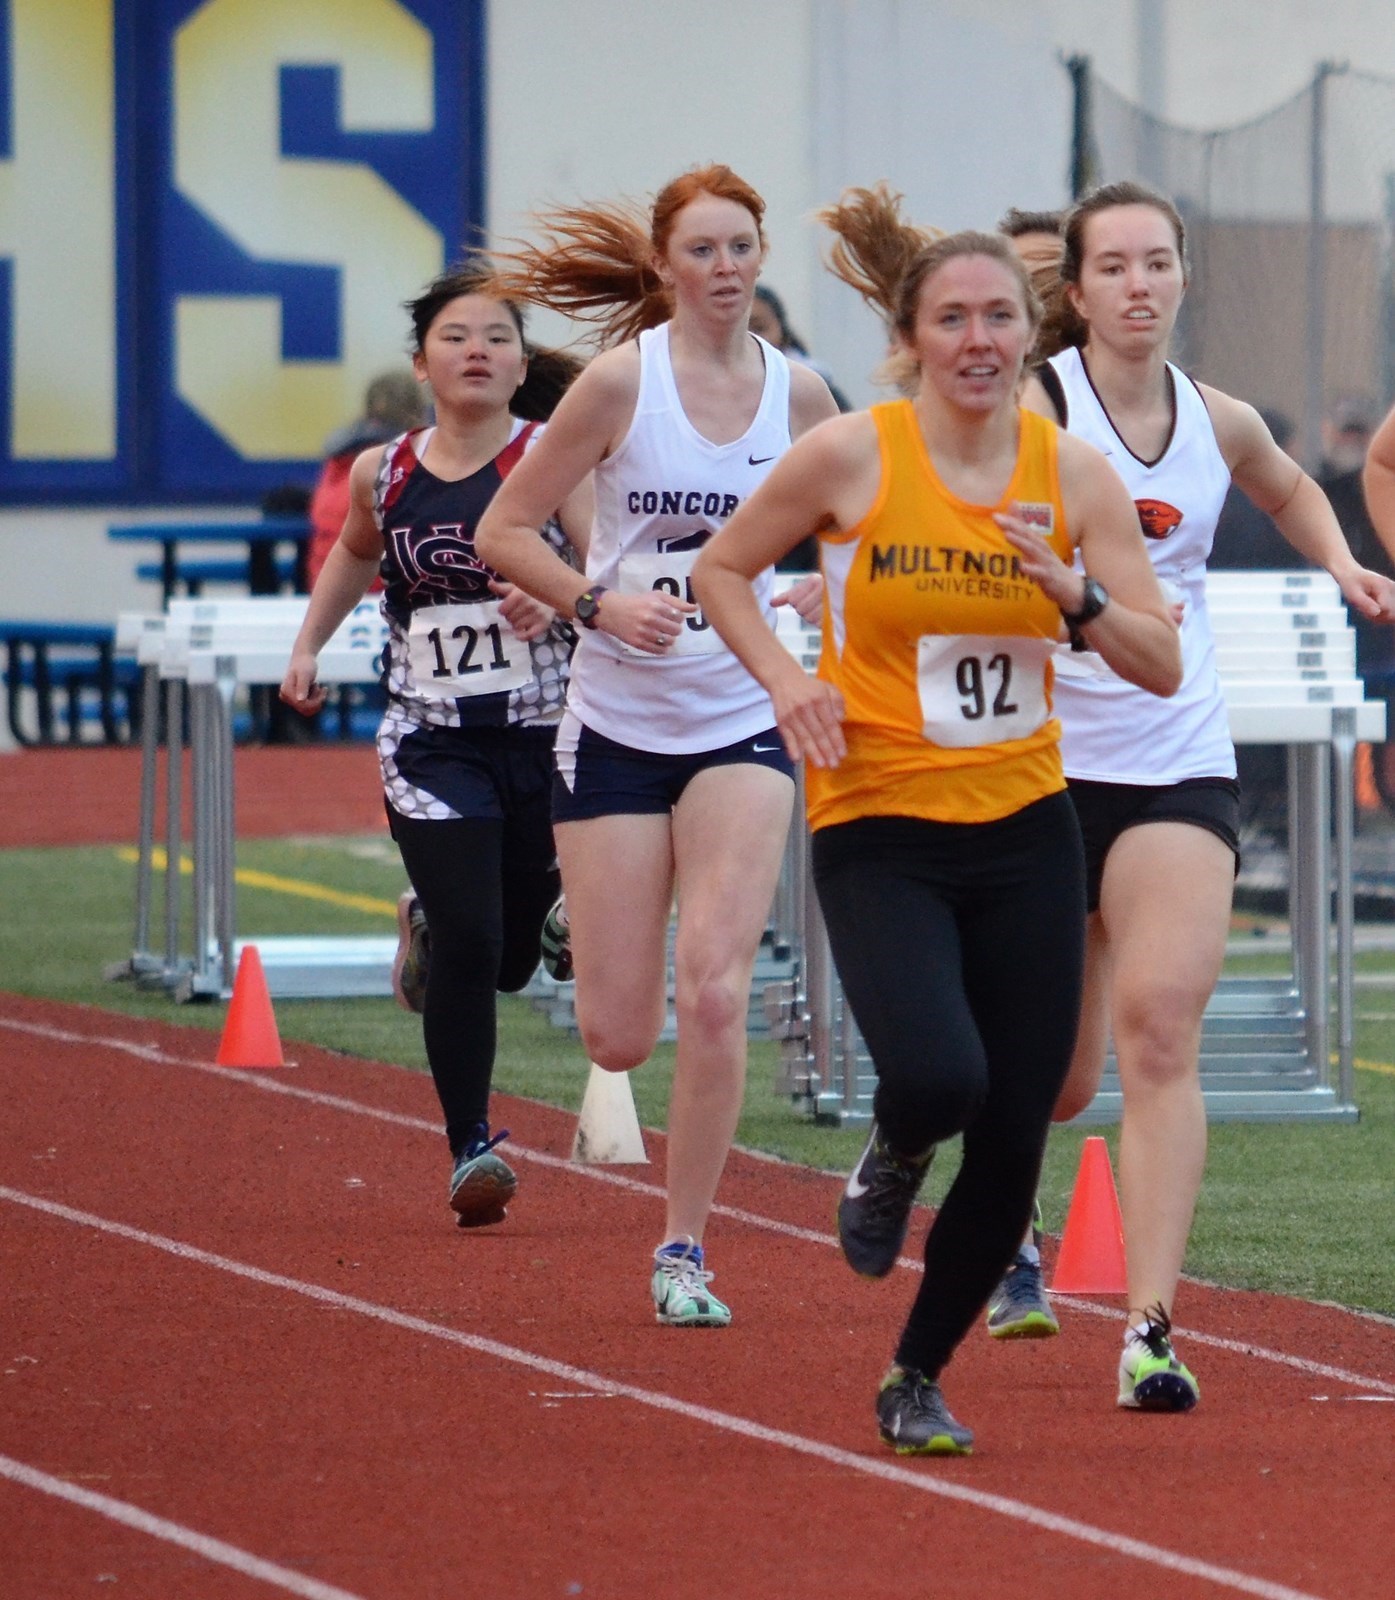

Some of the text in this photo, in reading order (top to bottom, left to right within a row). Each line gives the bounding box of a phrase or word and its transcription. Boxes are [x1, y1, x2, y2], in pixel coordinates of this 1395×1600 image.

[627, 491, 746, 517] CONCOR
[916, 577, 1035, 601] UNIVERSITY
[427, 623, 512, 678] 121
[956, 653, 1018, 720] 92
